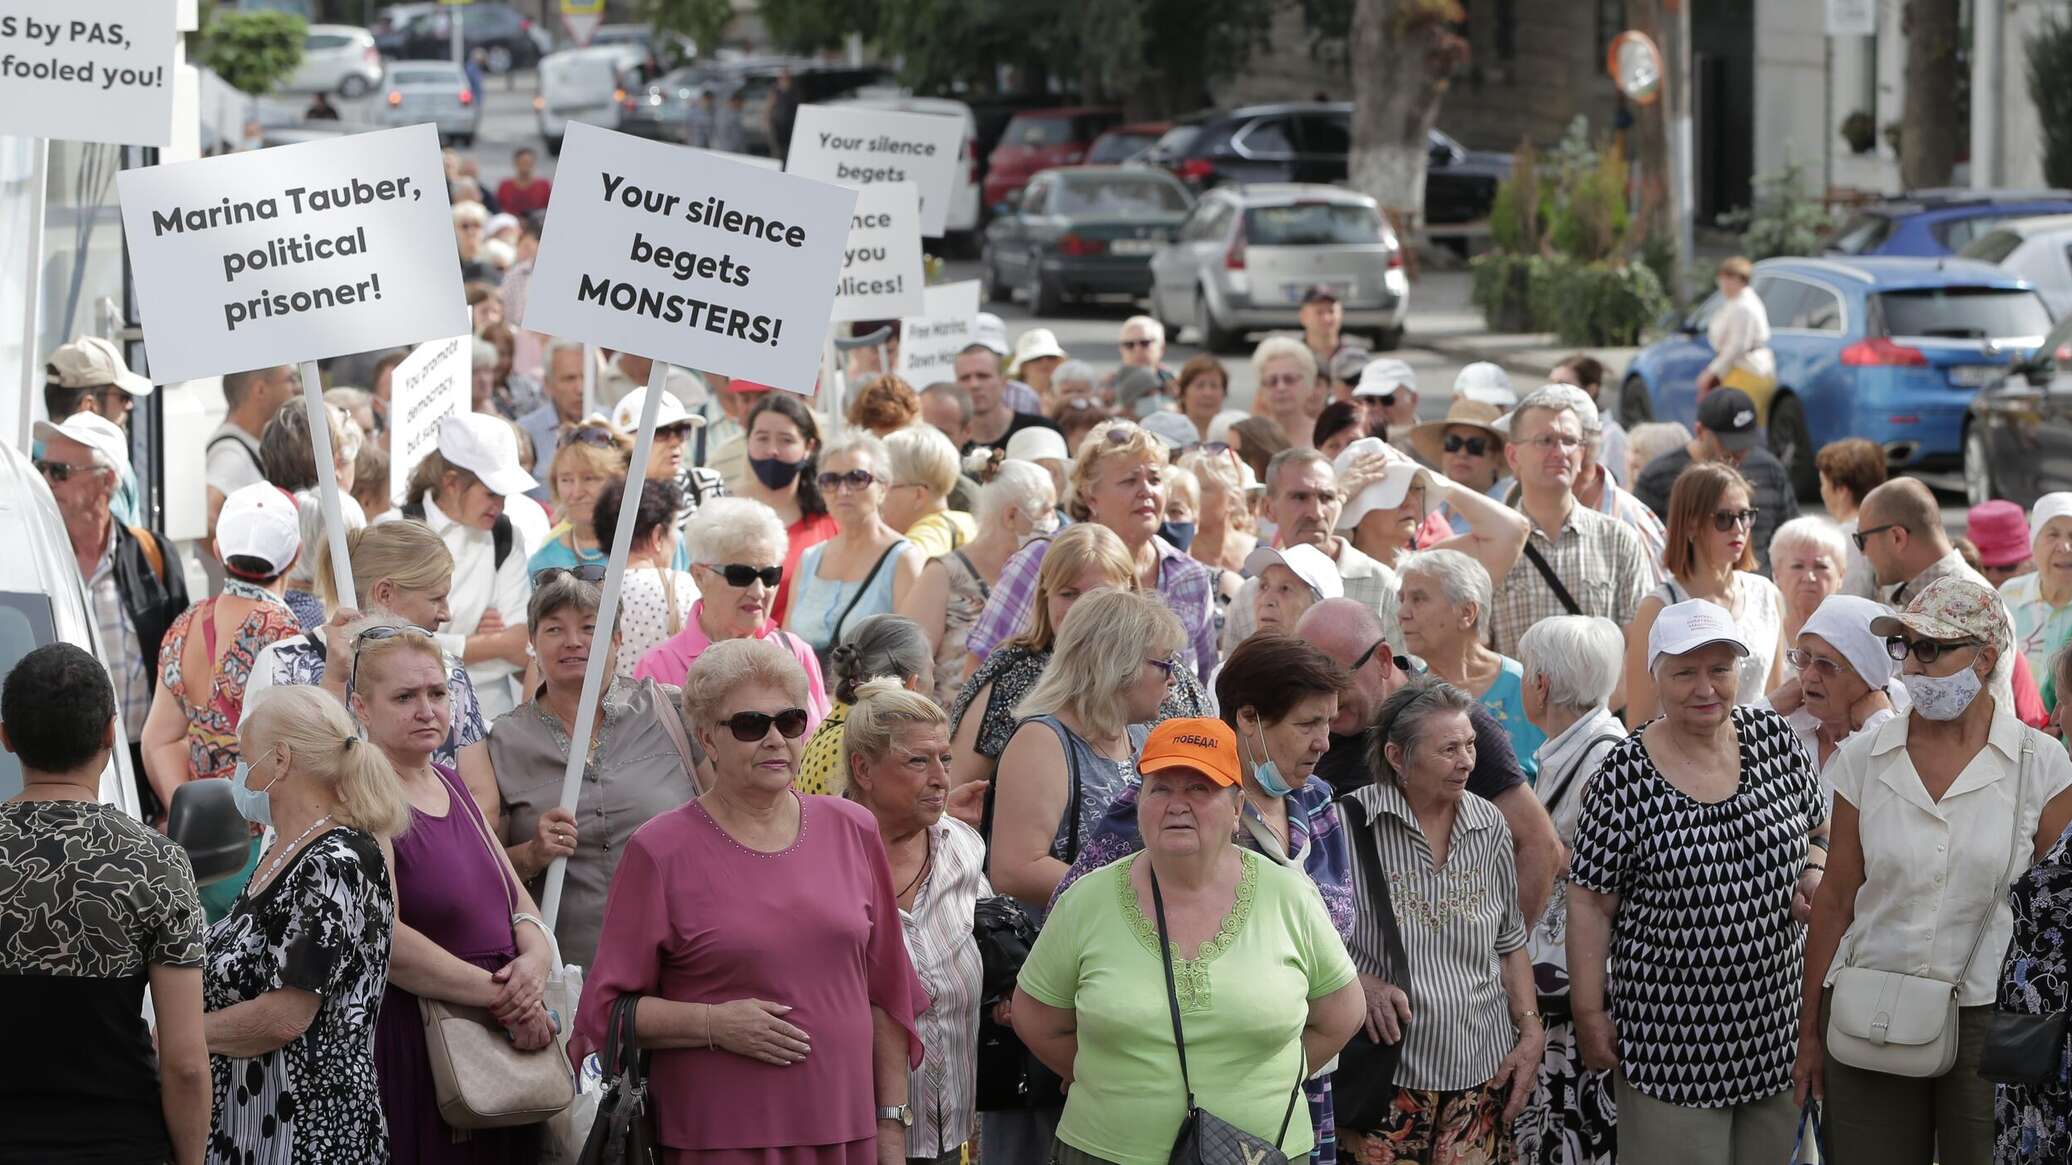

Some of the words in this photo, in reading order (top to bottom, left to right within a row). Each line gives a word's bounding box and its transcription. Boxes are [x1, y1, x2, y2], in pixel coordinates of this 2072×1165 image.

[26, 17, 61, 46] by
[70, 21, 131, 50] PAS,
[2, 54, 93, 82] fooled
[102, 66, 163, 90] you!
[819, 132, 863, 150] Your
[868, 134, 936, 157] silence
[836, 162, 905, 184] begets
[152, 197, 278, 236] Marina
[285, 177, 421, 214] Tauber,
[602, 172, 680, 216] Your
[685, 196, 806, 247] silence
[223, 226, 367, 282] political
[630, 232, 751, 287] begets
[843, 247, 886, 268] you
[224, 273, 382, 331] prisoner!
[577, 274, 783, 347] MONSTERS!
[1172, 735, 1218, 749] ПОБЕДА!
